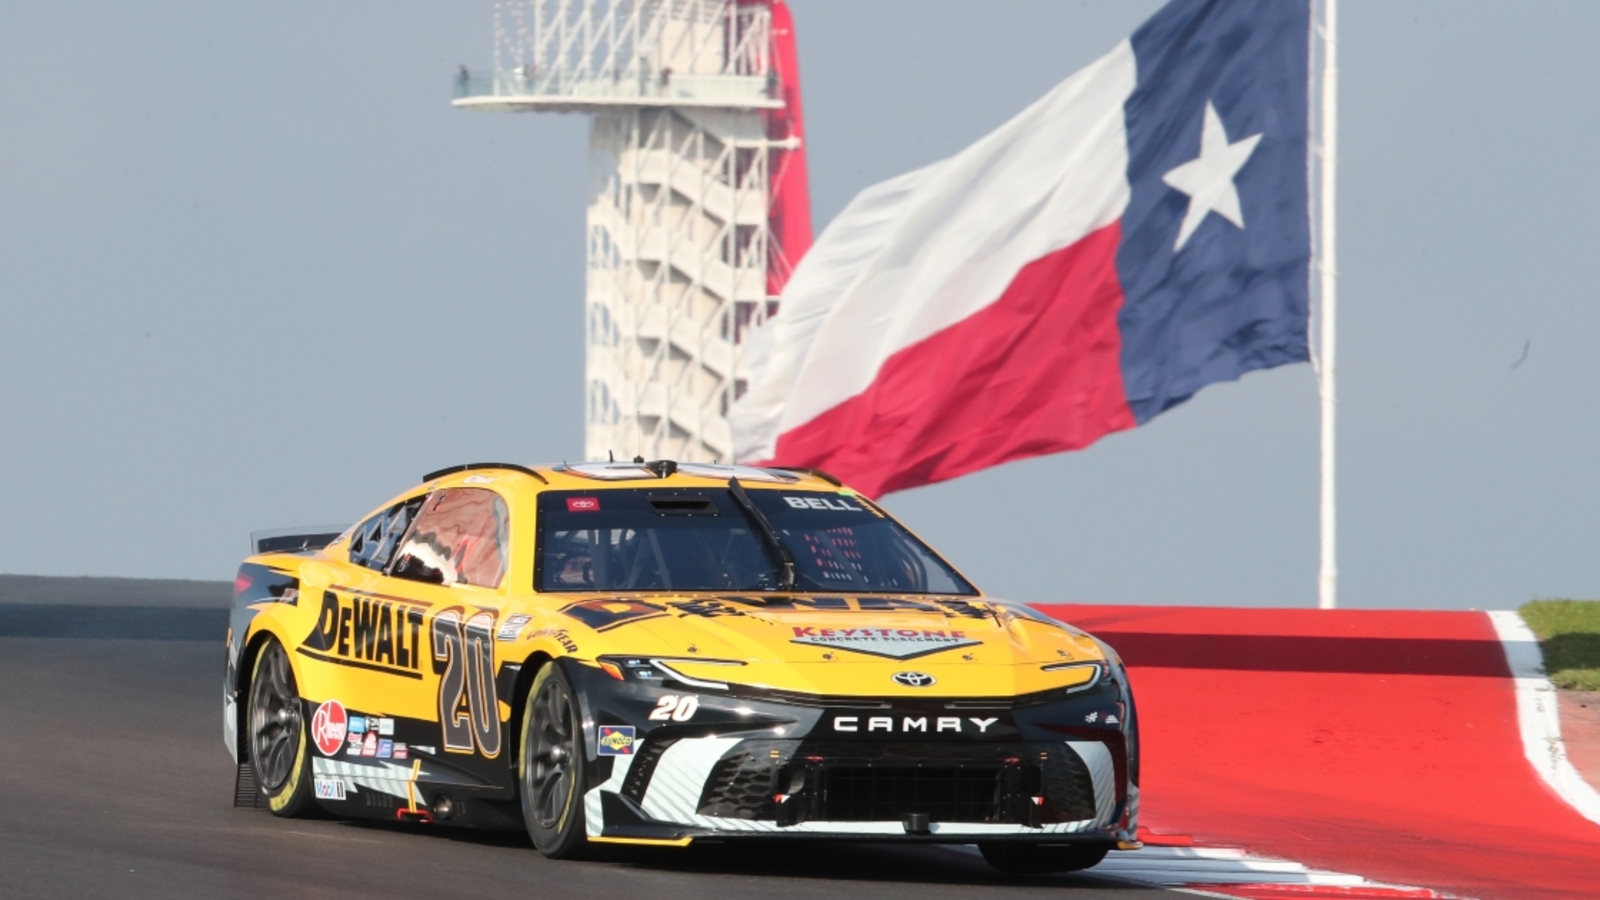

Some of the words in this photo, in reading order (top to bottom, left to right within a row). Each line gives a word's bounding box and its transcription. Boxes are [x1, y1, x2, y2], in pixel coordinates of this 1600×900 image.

[783, 496, 863, 511] BELL
[792, 626, 966, 638] KEYSTONE
[431, 606, 501, 759] 20
[648, 694, 699, 722] 20
[833, 716, 999, 733] CAMRY
[602, 737, 632, 746] SUNOCO
